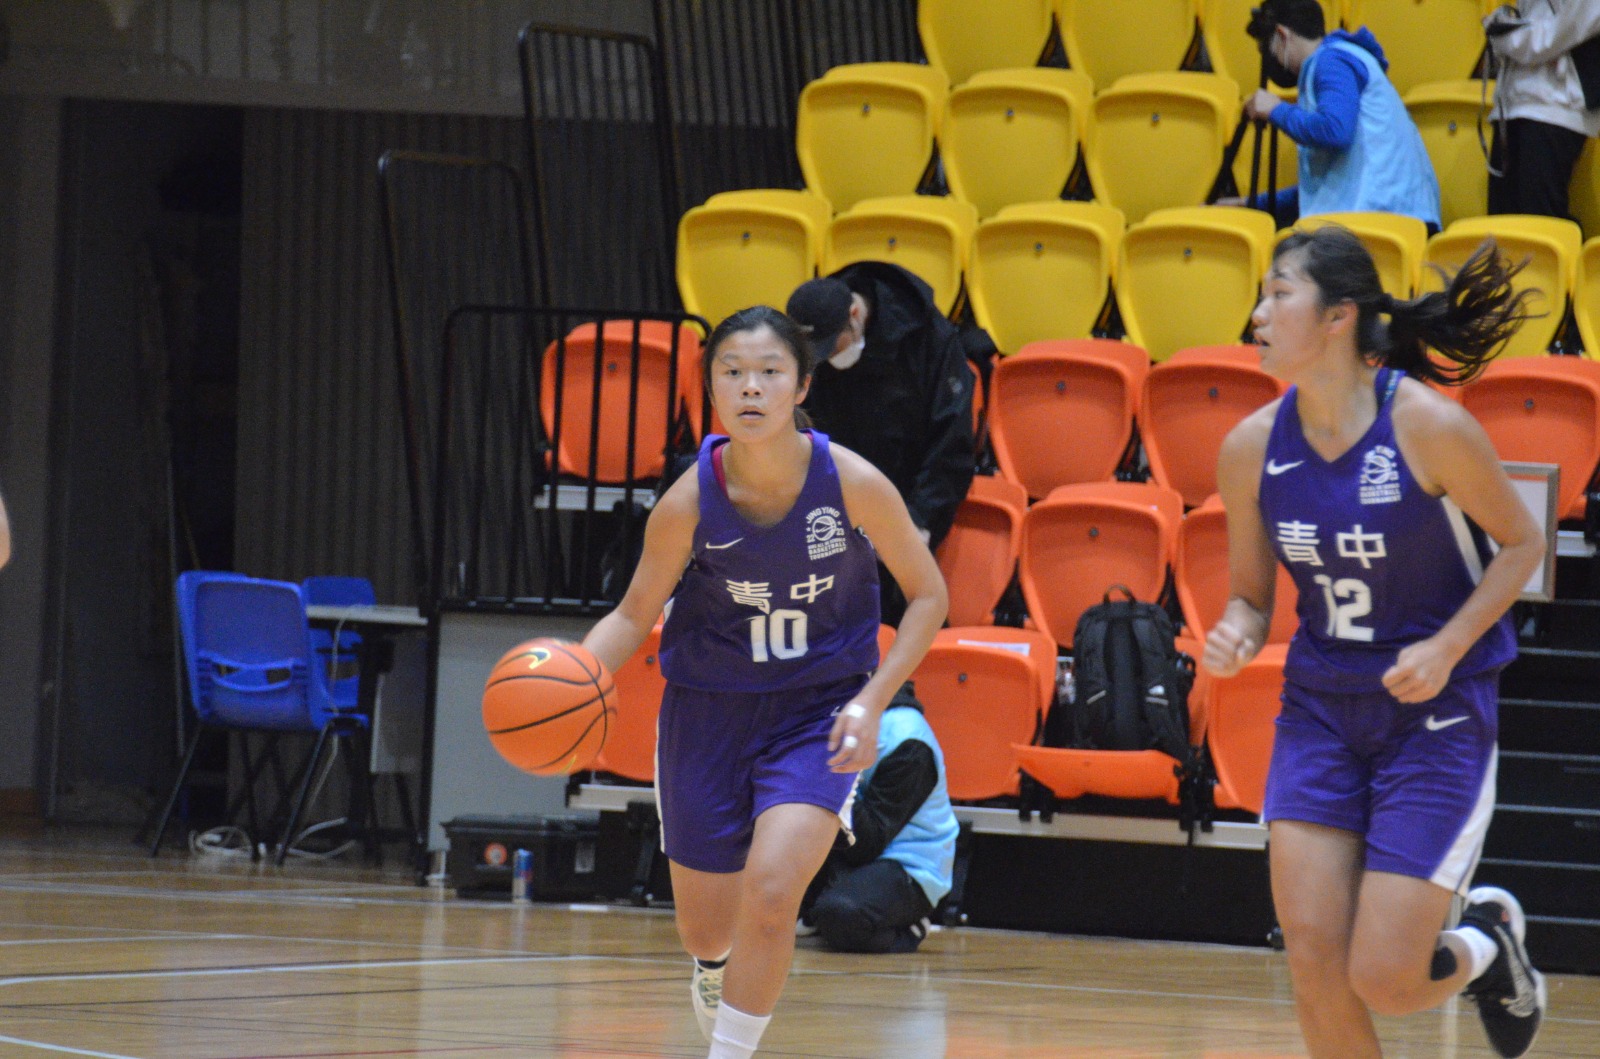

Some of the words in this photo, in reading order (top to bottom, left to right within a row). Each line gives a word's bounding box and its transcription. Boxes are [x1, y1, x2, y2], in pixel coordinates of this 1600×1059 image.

[821, 506, 841, 518] YING
[808, 541, 847, 555] BASKETBALL
[809, 546, 847, 561] TOURNAMENT
[1277, 520, 1387, 569] 青中
[726, 574, 834, 615] 青中
[1313, 574, 1374, 642] 12
[745, 609, 809, 662] 10
